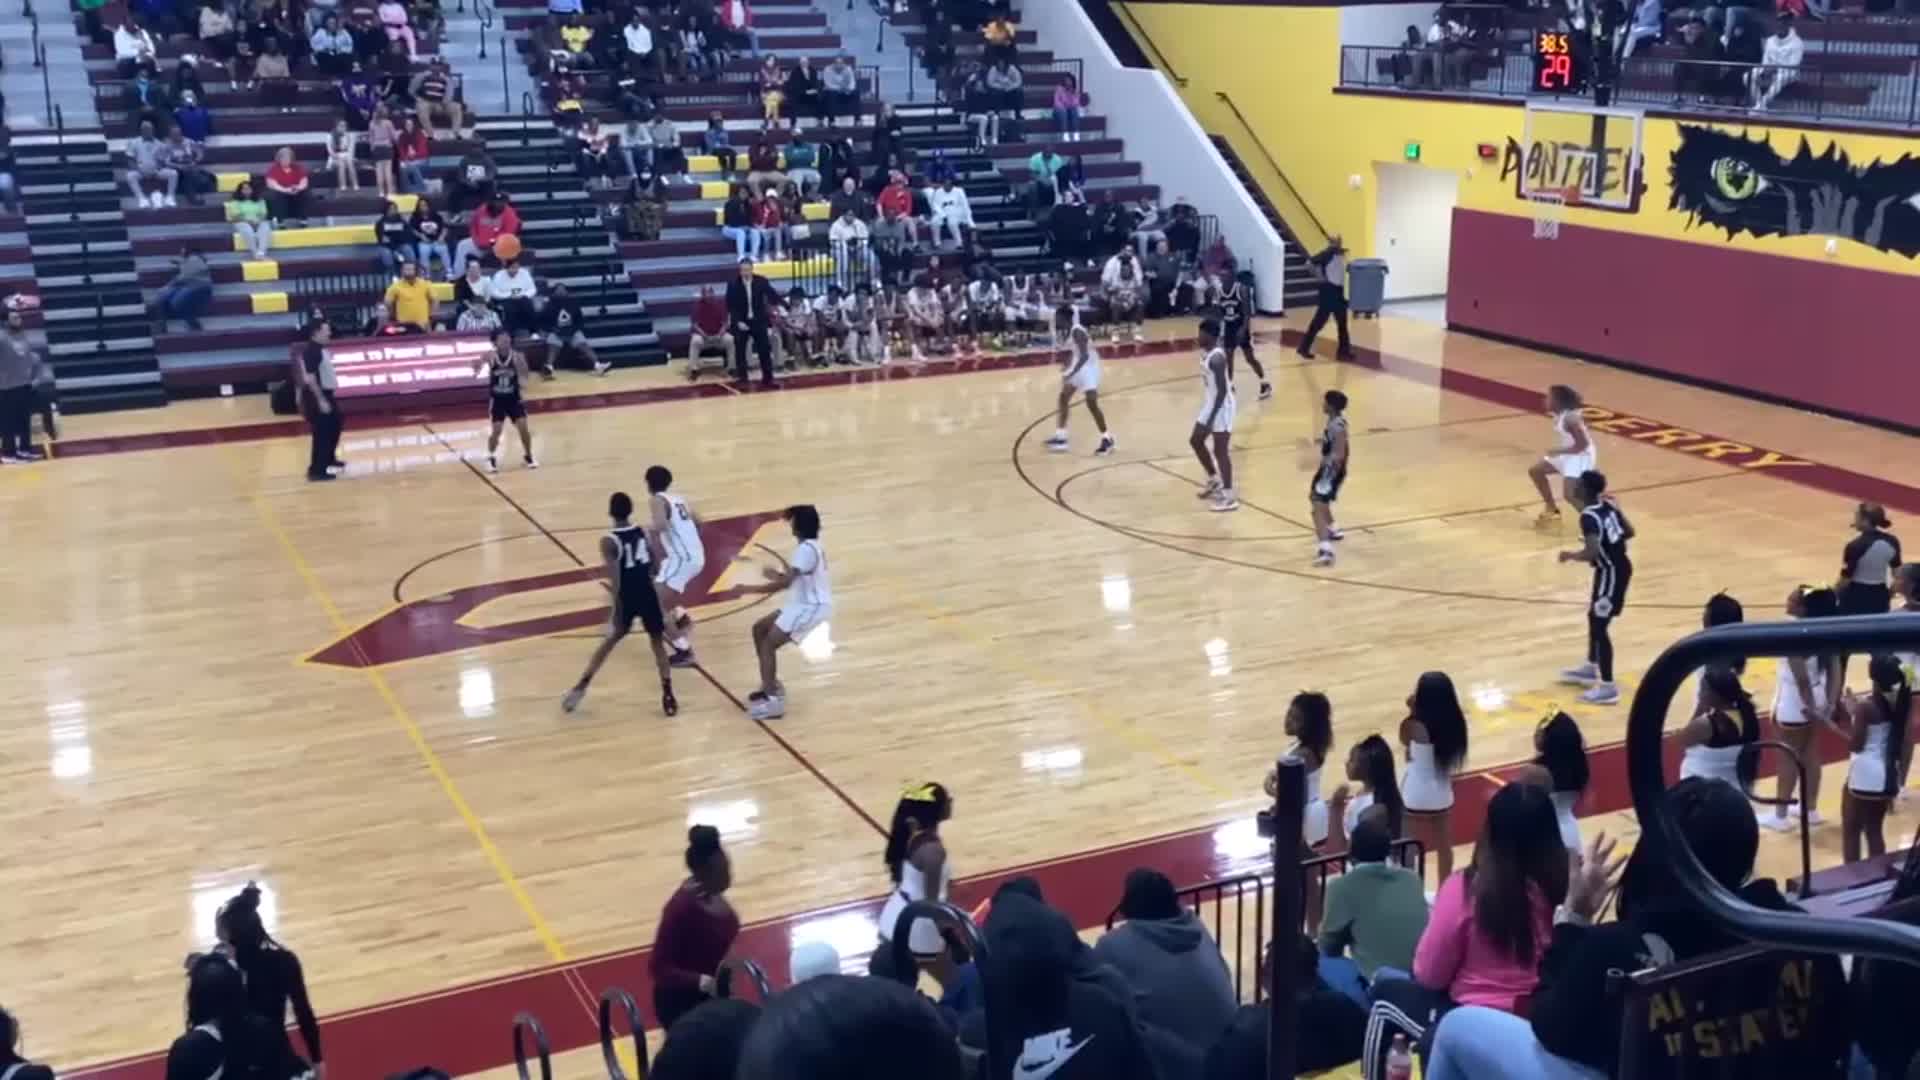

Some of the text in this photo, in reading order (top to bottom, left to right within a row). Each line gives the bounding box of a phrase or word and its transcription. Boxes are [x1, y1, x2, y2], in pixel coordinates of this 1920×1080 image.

[1541, 55, 1570, 88] 29
[1580, 406, 1816, 467] PERRY
[624, 538, 649, 569] 14
[1023, 1027, 1072, 1060] NIKE
